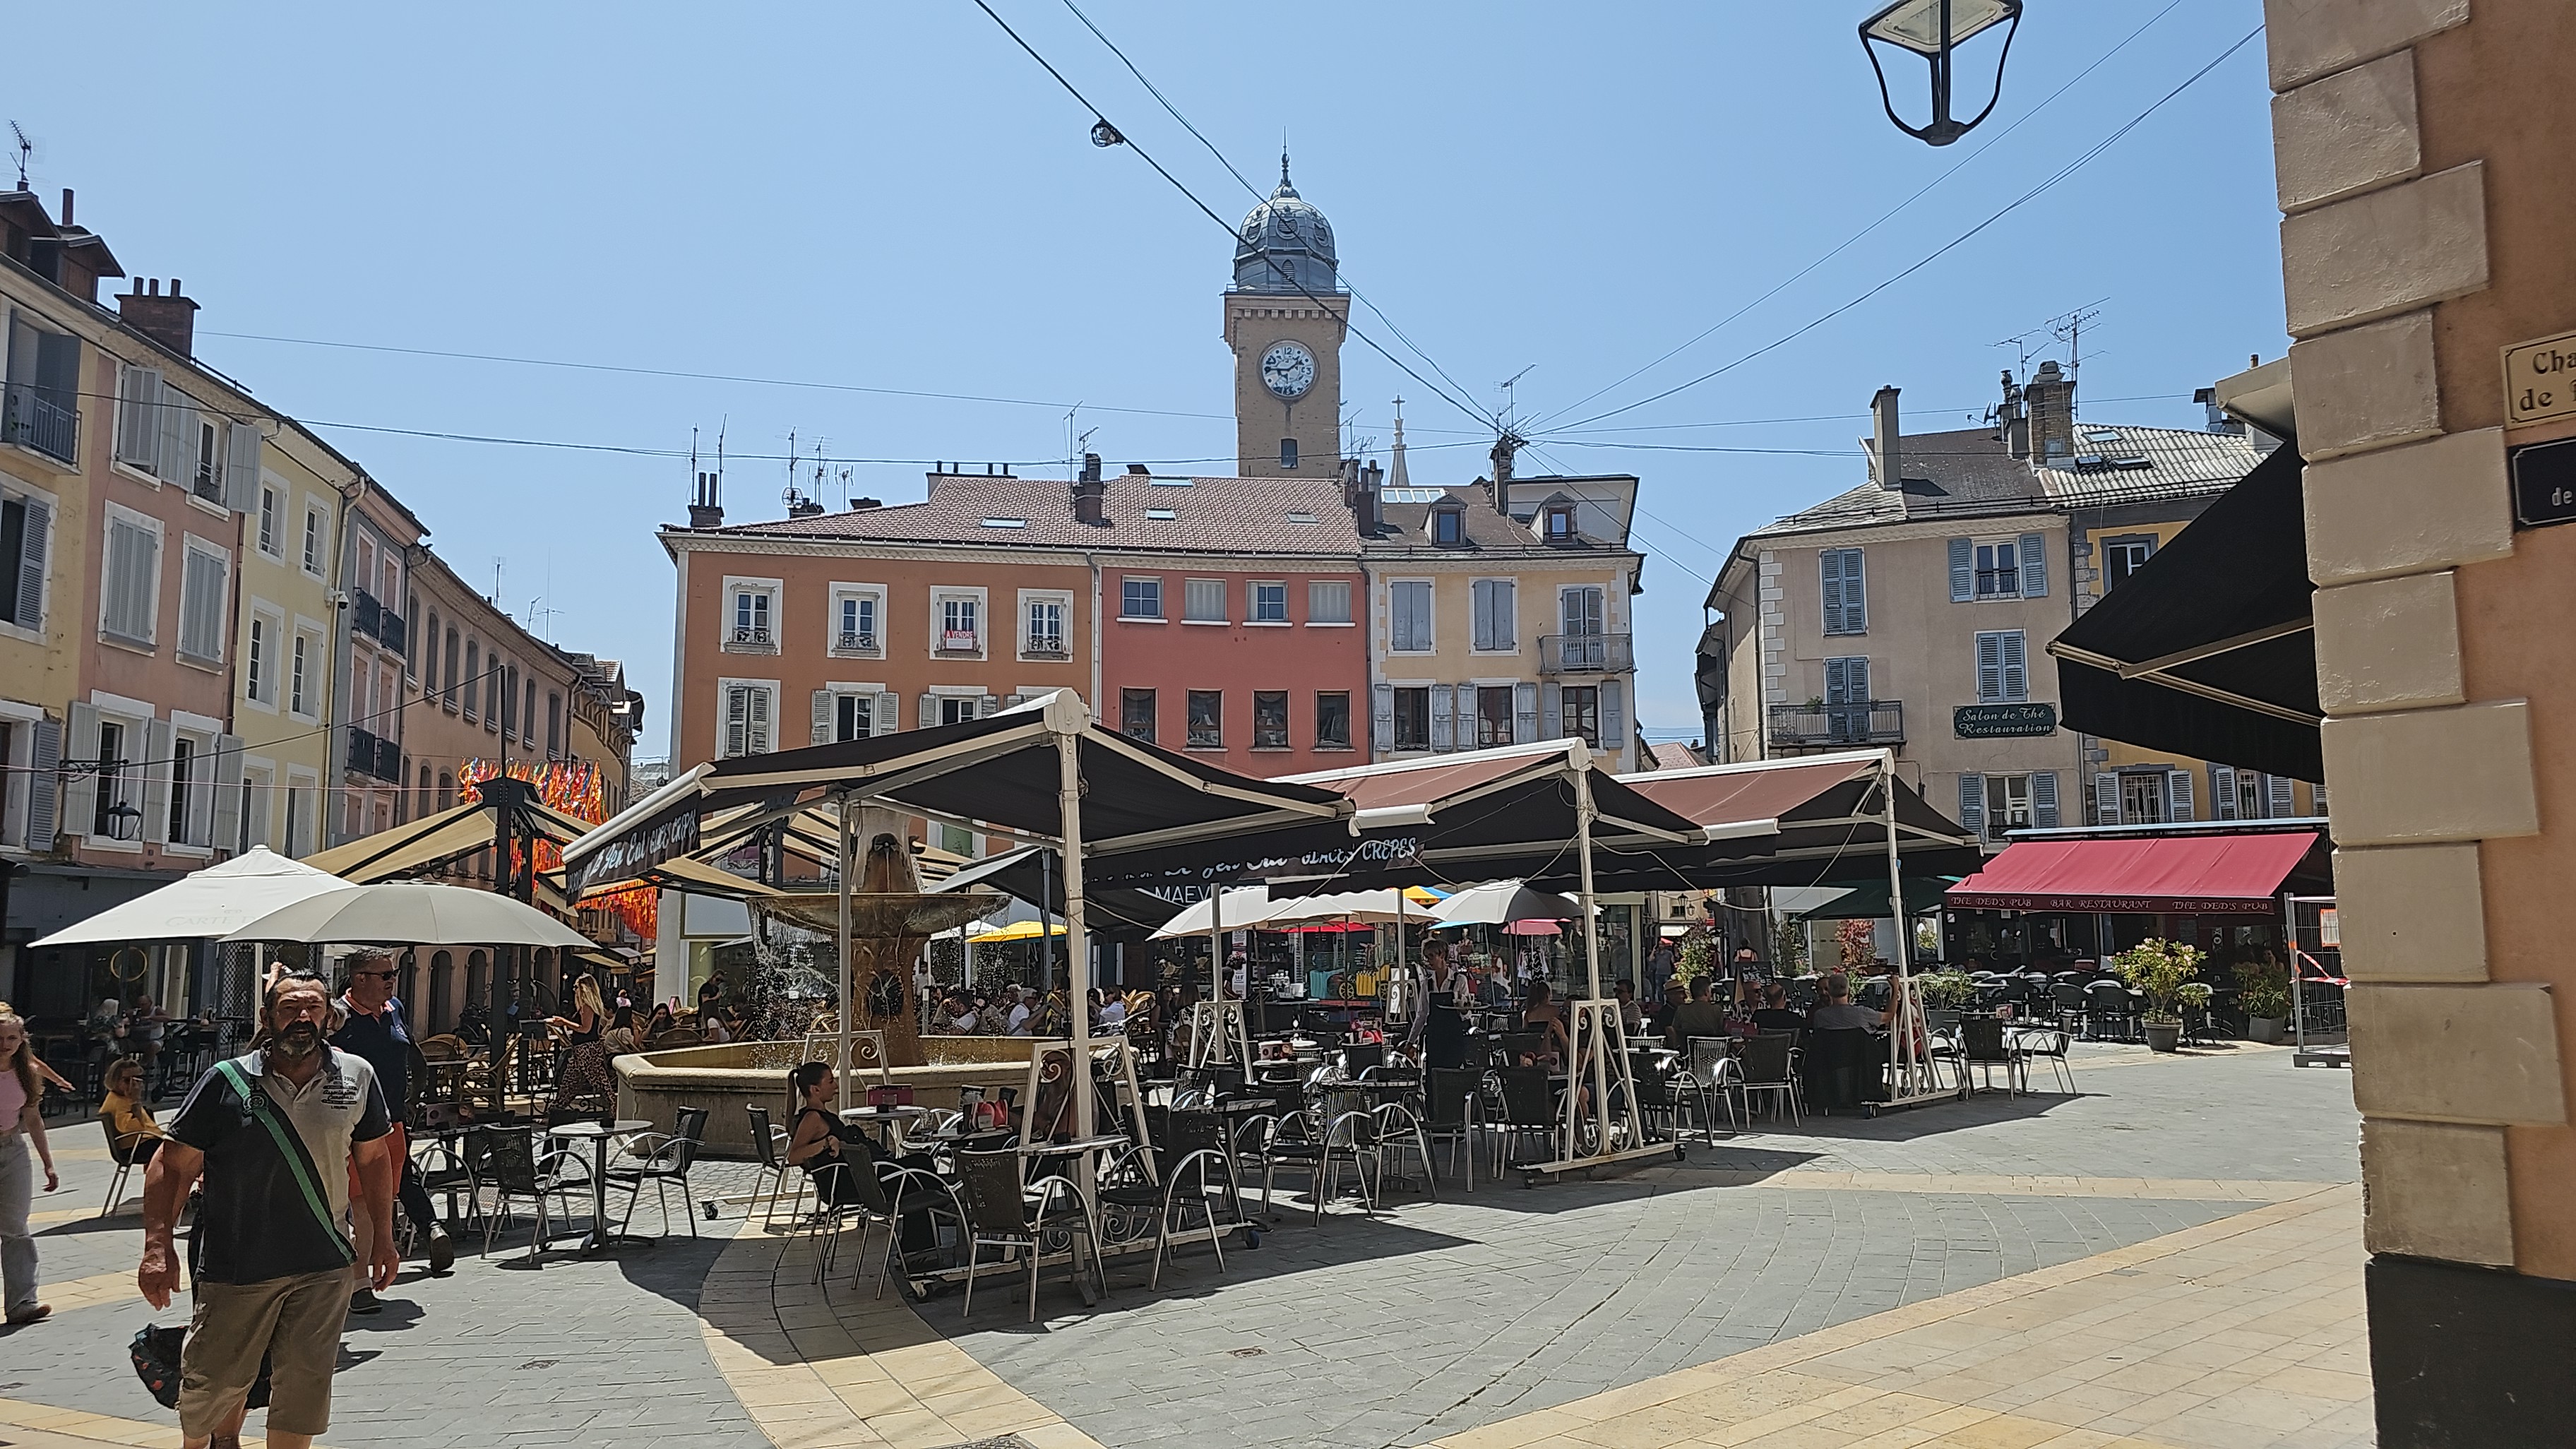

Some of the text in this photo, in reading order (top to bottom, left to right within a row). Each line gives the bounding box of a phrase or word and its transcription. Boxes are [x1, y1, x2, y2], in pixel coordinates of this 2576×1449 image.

[2520, 388, 2553, 412] de
[2551, 487, 2573, 506] de
[952, 631, 973, 639] VENDRE
[1962, 707, 2046, 722] Salon de Thé
[1959, 722, 2052, 734] Restauration
[1950, 896, 1972, 905] THE
[1975, 897, 2005, 906] DED'S
[2009, 898, 2032, 907] PUB
[2050, 899, 2075, 909] BAR
[2078, 899, 2152, 910] RESTAURANT
[2172, 901, 2197, 910] THE
[2200, 902, 2237, 910] DED'S
